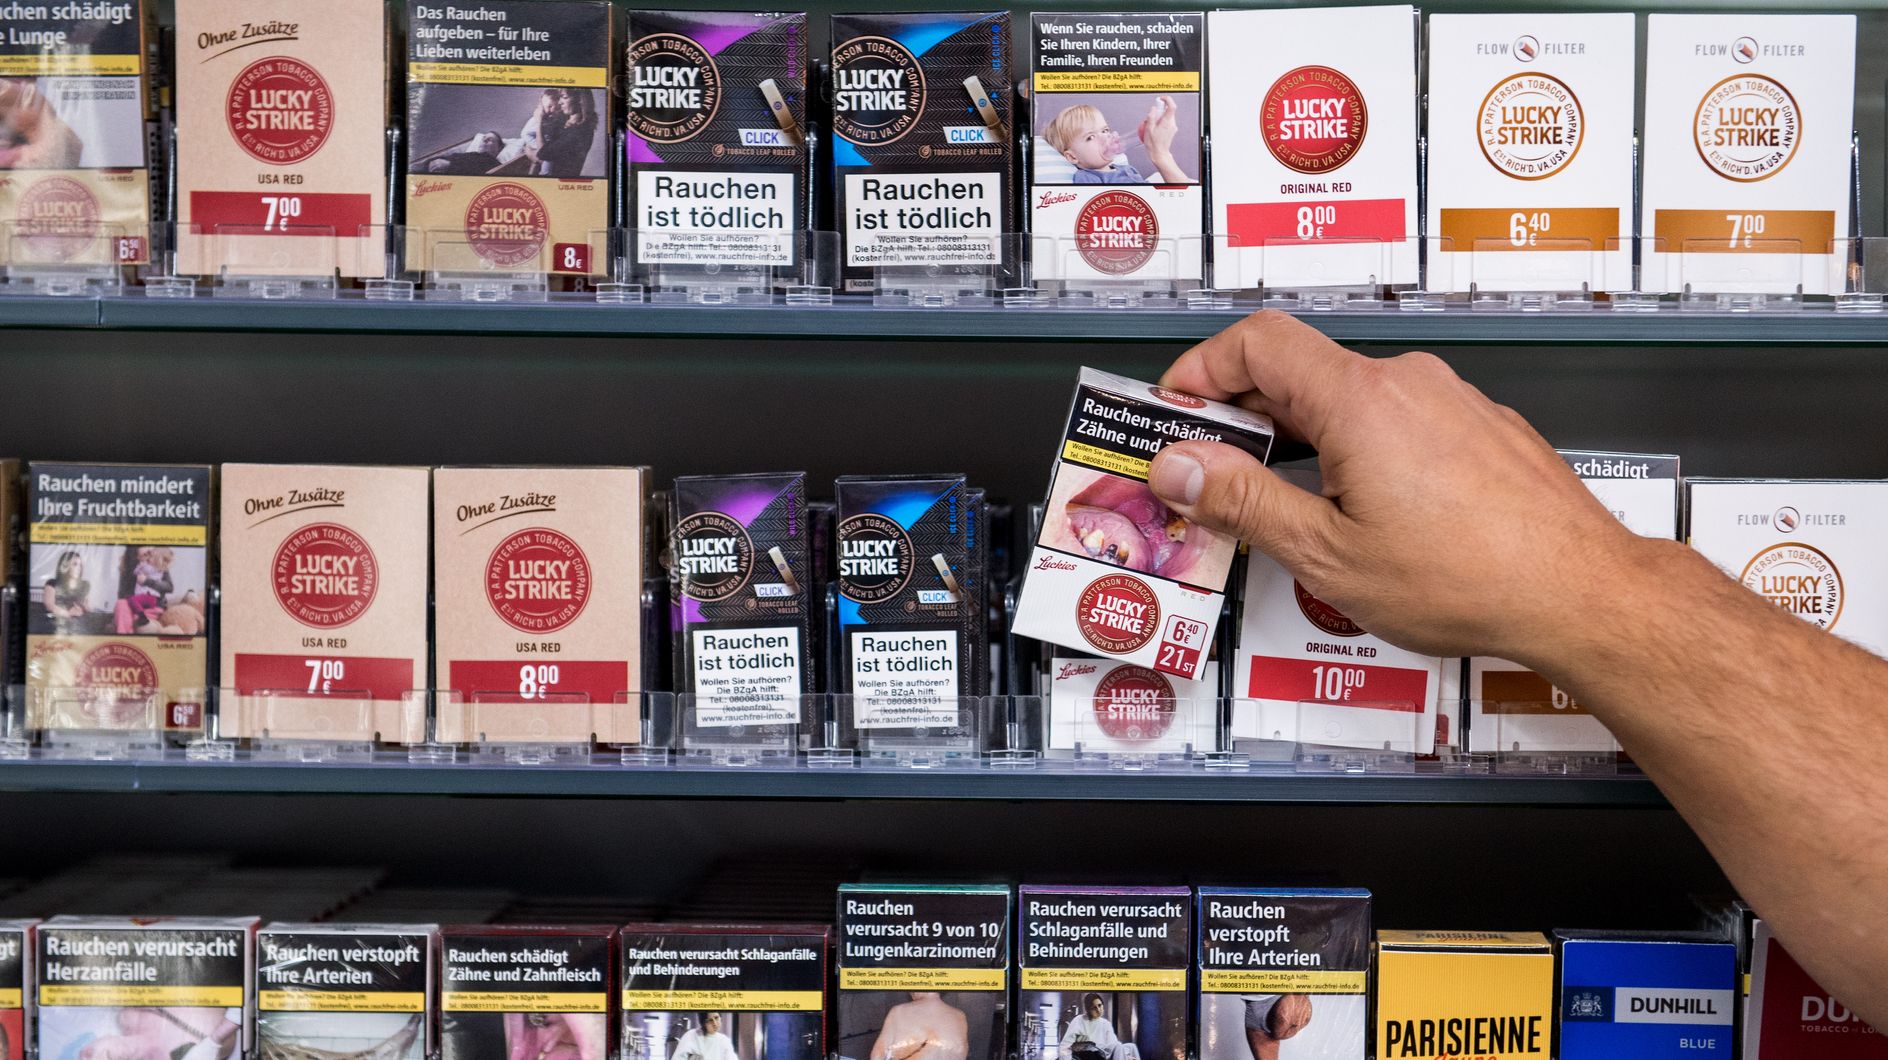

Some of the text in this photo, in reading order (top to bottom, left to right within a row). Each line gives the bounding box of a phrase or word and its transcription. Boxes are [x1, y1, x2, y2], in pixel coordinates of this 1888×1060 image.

[52, 1, 132, 24] schädigt
[417, 6, 506, 21] Das Rauchen
[198, 21, 299, 50] Ohne Zusätze
[416, 25, 549, 42] aufgeben für Ihre
[1040, 22, 1193, 34] Wenn Sie rauchen, schaden
[10, 28, 66, 50] Lunge
[1041, 38, 1170, 51] Sie Ihren Kindern, Ihrer
[416, 44, 550, 61] Lieben weiterleben
[1477, 43, 1585, 55] FLOW FILTER
[1041, 54, 1173, 67] Familie, Ihren Freunden
[634, 67, 699, 86] LUCKY
[839, 70, 904, 89] LUCKY
[250, 90, 312, 109] LUCKY
[631, 89, 701, 108] STRIKE
[836, 91, 906, 111] STRIKE
[1283, 98, 1345, 119] LUCKY
[1502, 106, 1561, 124] LUCKY
[1528, 80, 1576, 146] TOBACCO COMPANY
[1719, 108, 1779, 126] LUCKY
[246, 111, 314, 130] STRIKE
[1280, 119, 1348, 140] STRIKE
[746, 132, 779, 143] CLICK
[951, 129, 984, 141] CLICK
[1498, 127, 1562, 145] STRIKE
[1714, 129, 1779, 146] STRIKE
[258, 174, 303, 184] USA RED
[863, 178, 983, 200] Rauchen
[1281, 183, 1352, 194] ORIGINAL RED
[1037, 191, 1077, 209] Luckies
[484, 208, 532, 223] LUCKY
[856, 207, 991, 229] ist tödlich
[1093, 217, 1142, 232] LUCKY
[480, 225, 533, 240] STRIKE
[1090, 233, 1143, 248] STRIKE
[1083, 398, 1150, 430] Rauchen
[1077, 418, 1161, 453] Zähne und
[1072, 443, 1092, 453] Wollen
[1093, 447, 1103, 456] Sie
[1134, 459, 1145, 467] Die
[1082, 454, 1122, 471] 08008313131
[1574, 458, 1649, 479] schädigt
[38, 473, 194, 494] Rauchen mindert
[38, 498, 200, 519] Ihre Fruchtbarkeit
[244, 489, 344, 515] Ohne Zusätze
[1738, 515, 1846, 525] FLOW FILTER
[682, 537, 736, 555] LUCKY
[295, 555, 359, 574] LUCKY
[508, 560, 570, 580] LUCKY
[679, 556, 738, 574] STRIKE
[1034, 555, 1077, 571] Luckies
[291, 575, 359, 595] STRIKE
[504, 581, 572, 600] STRIKE
[1762, 576, 1821, 593] LUCKY
[1096, 593, 1147, 618] LUCKY
[1089, 608, 1144, 635] STRIKE
[704, 634, 788, 650] Rauchen
[862, 636, 946, 652] Rauchen
[1306, 642, 1377, 658] ORIGINAL RED
[699, 653, 794, 670] ist tödlich
[857, 656, 952, 672] ist tödlich
[1160, 646, 1195, 673] 21 ST
[1056, 662, 1097, 680] Luckies
[847, 900, 914, 916] Rauchen
[1030, 901, 1182, 917] Rauchen verursacht
[1210, 901, 1285, 919] Rauchen
[846, 921, 999, 937] verursacht 9 von 10
[1030, 922, 1167, 941] Schlaganfälle und
[1209, 925, 1289, 946] verstopft
[47, 936, 237, 957] Rauchen verursacht
[266, 944, 420, 966] Rauchen verstopft
[629, 948, 816, 963] Rauchen verursacht Schlaganfälle
[846, 942, 996, 960] Lungenkarzinomen
[1030, 943, 1148, 962] Behinderungen
[449, 949, 569, 966] Rauchen schädigt
[1210, 947, 1320, 966] Ihre Arterien
[47, 961, 157, 981] Herzanfälle
[266, 967, 372, 984] Ihre Arterien
[449, 967, 601, 982] Zähne und Zahnfleisch
[629, 964, 740, 978] und Behinderungen
[1630, 997, 1717, 1014] DUNHILL
[1386, 1016, 1541, 1058] PARISIENNE
[1680, 1039, 1715, 1049] BLUE
